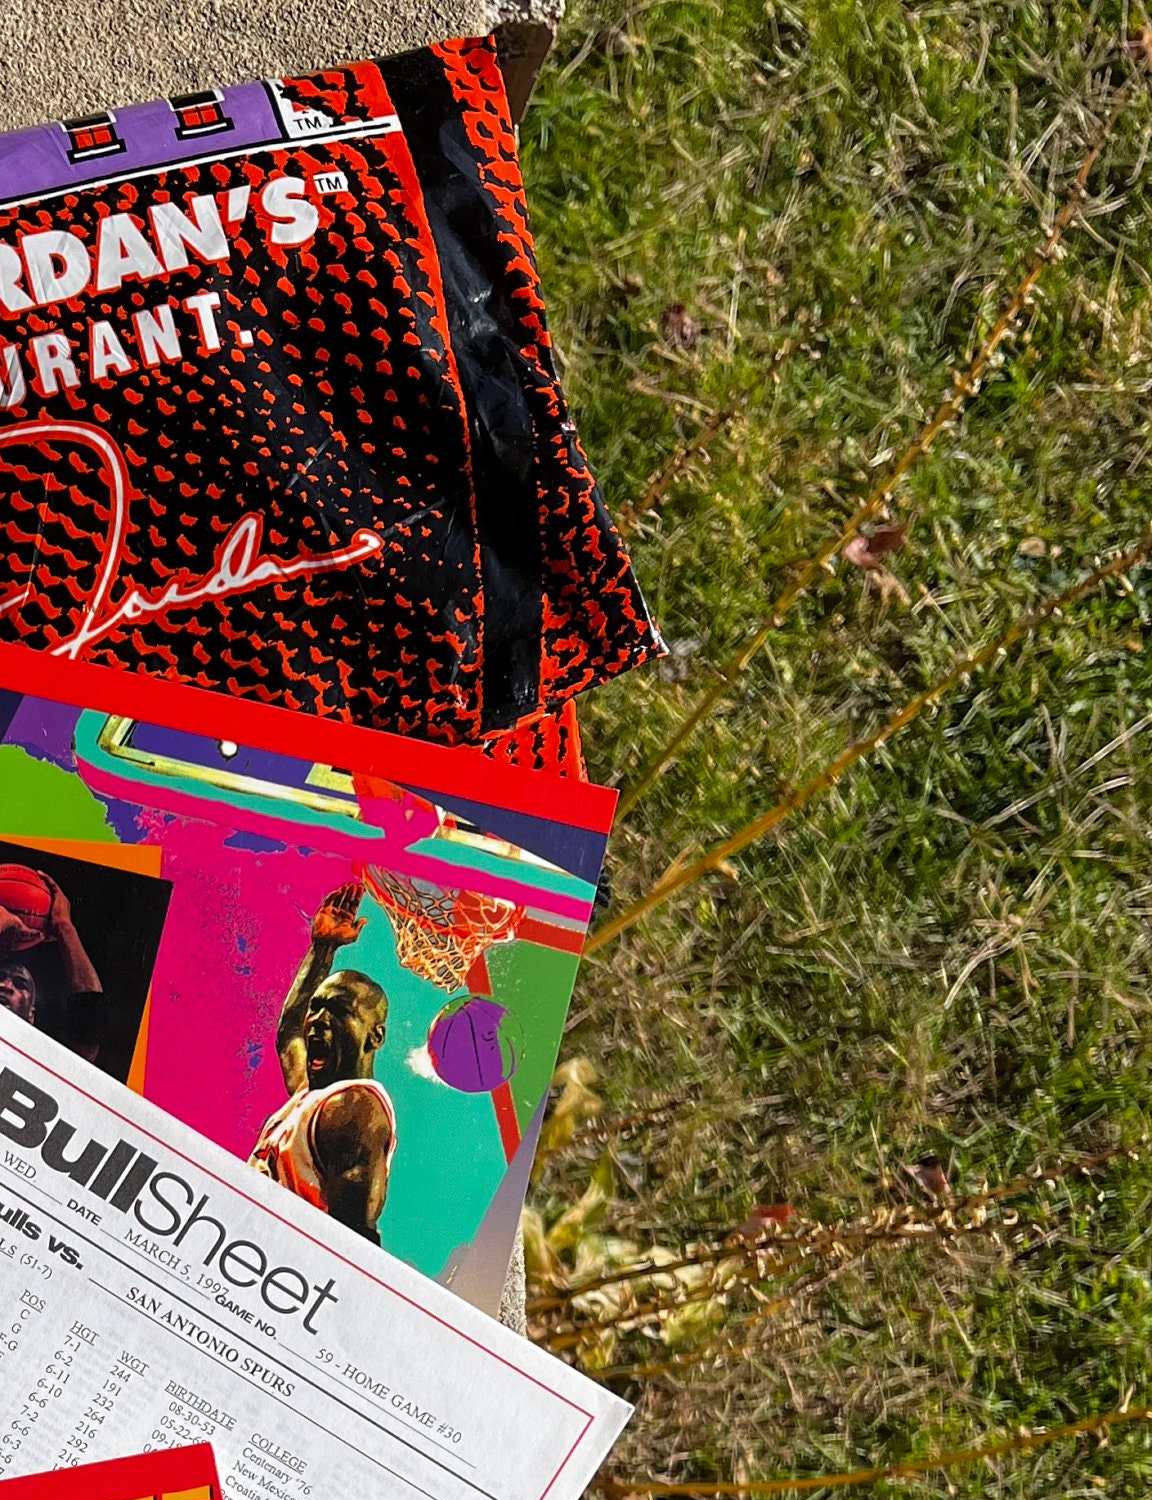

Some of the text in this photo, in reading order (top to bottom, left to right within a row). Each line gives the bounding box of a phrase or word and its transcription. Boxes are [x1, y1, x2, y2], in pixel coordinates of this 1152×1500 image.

[19, 1253, 52, 1280] (51-7)
[48, 1234, 83, 1270] vs.
[125, 1287, 161, 1314] SAN
[160, 1310, 238, 1362] ANTONIO
[239, 1358, 295, 1396] SPURS
[66, 1198, 102, 1226] DATE
[123, 1228, 180, 1269] MARCH
[172, 1264, 191, 1281] 5,
[195, 1273, 229, 1302] 1997
[214, 1294, 254, 1324] GAME
[254, 1319, 276, 1340] NO.
[315, 1348, 333, 1363] 59
[341, 1363, 390, 1399] HOME
[391, 1394, 436, 1428] GAME
[19, 1289, 46, 1311] POS
[69, 1320, 99, 1345] HGT
[116, 1350, 149, 1376] WGT
[164, 1379, 236, 1430] BIRTHDATE
[248, 1433, 307, 1473] COLLEGE
[91, 1392, 113, 1411] 232
[83, 1406, 105, 1425] 264
[109, 1364, 131, 1383] 244
[168, 1401, 215, 1436] 08-30-53
[242, 1447, 292, 1484] Centenary
[75, 1420, 97, 1439] 216
[102, 1379, 121, 1396] 191
[232, 1460, 257, 1480] New
[58, 1448, 80, 1466] 216
[66, 1434, 88, 1453] 292
